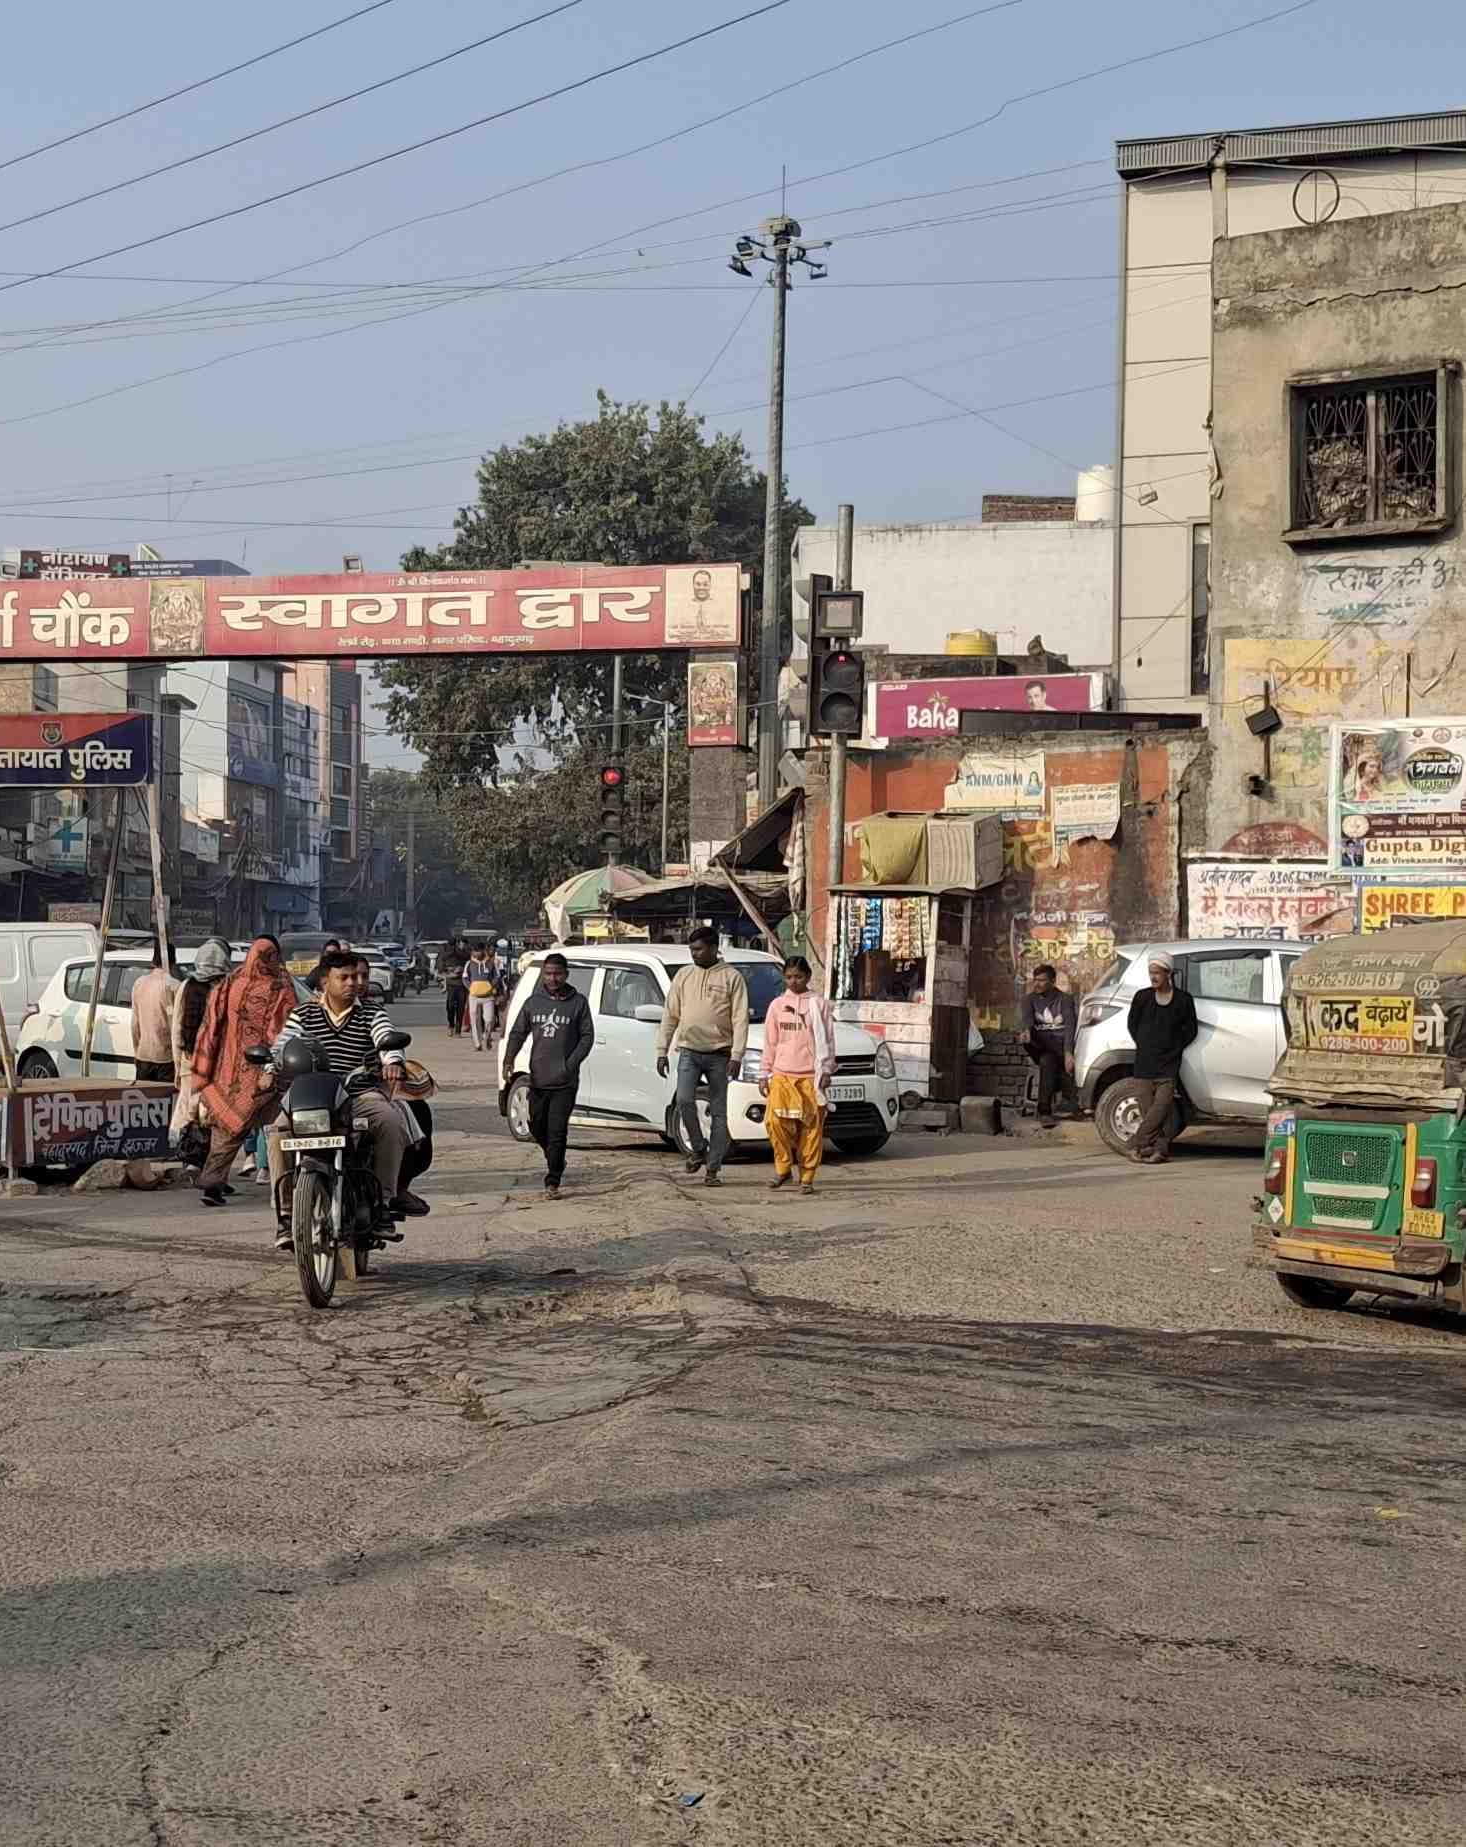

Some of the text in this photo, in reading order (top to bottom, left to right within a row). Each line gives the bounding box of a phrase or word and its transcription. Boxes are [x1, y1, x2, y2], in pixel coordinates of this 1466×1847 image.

[218, 585, 662, 632] स्वागत द्वार
[67, 740, 134, 781] पुलिस
[965, 773, 1023, 787] ANM/GNM
[1365, 838, 1424, 855] Gupta
[1365, 893, 1436, 917] SHREE
[543, 1025, 556, 1038] 23
[34, 1088, 171, 1141] ट्रैफिक पुलिस
